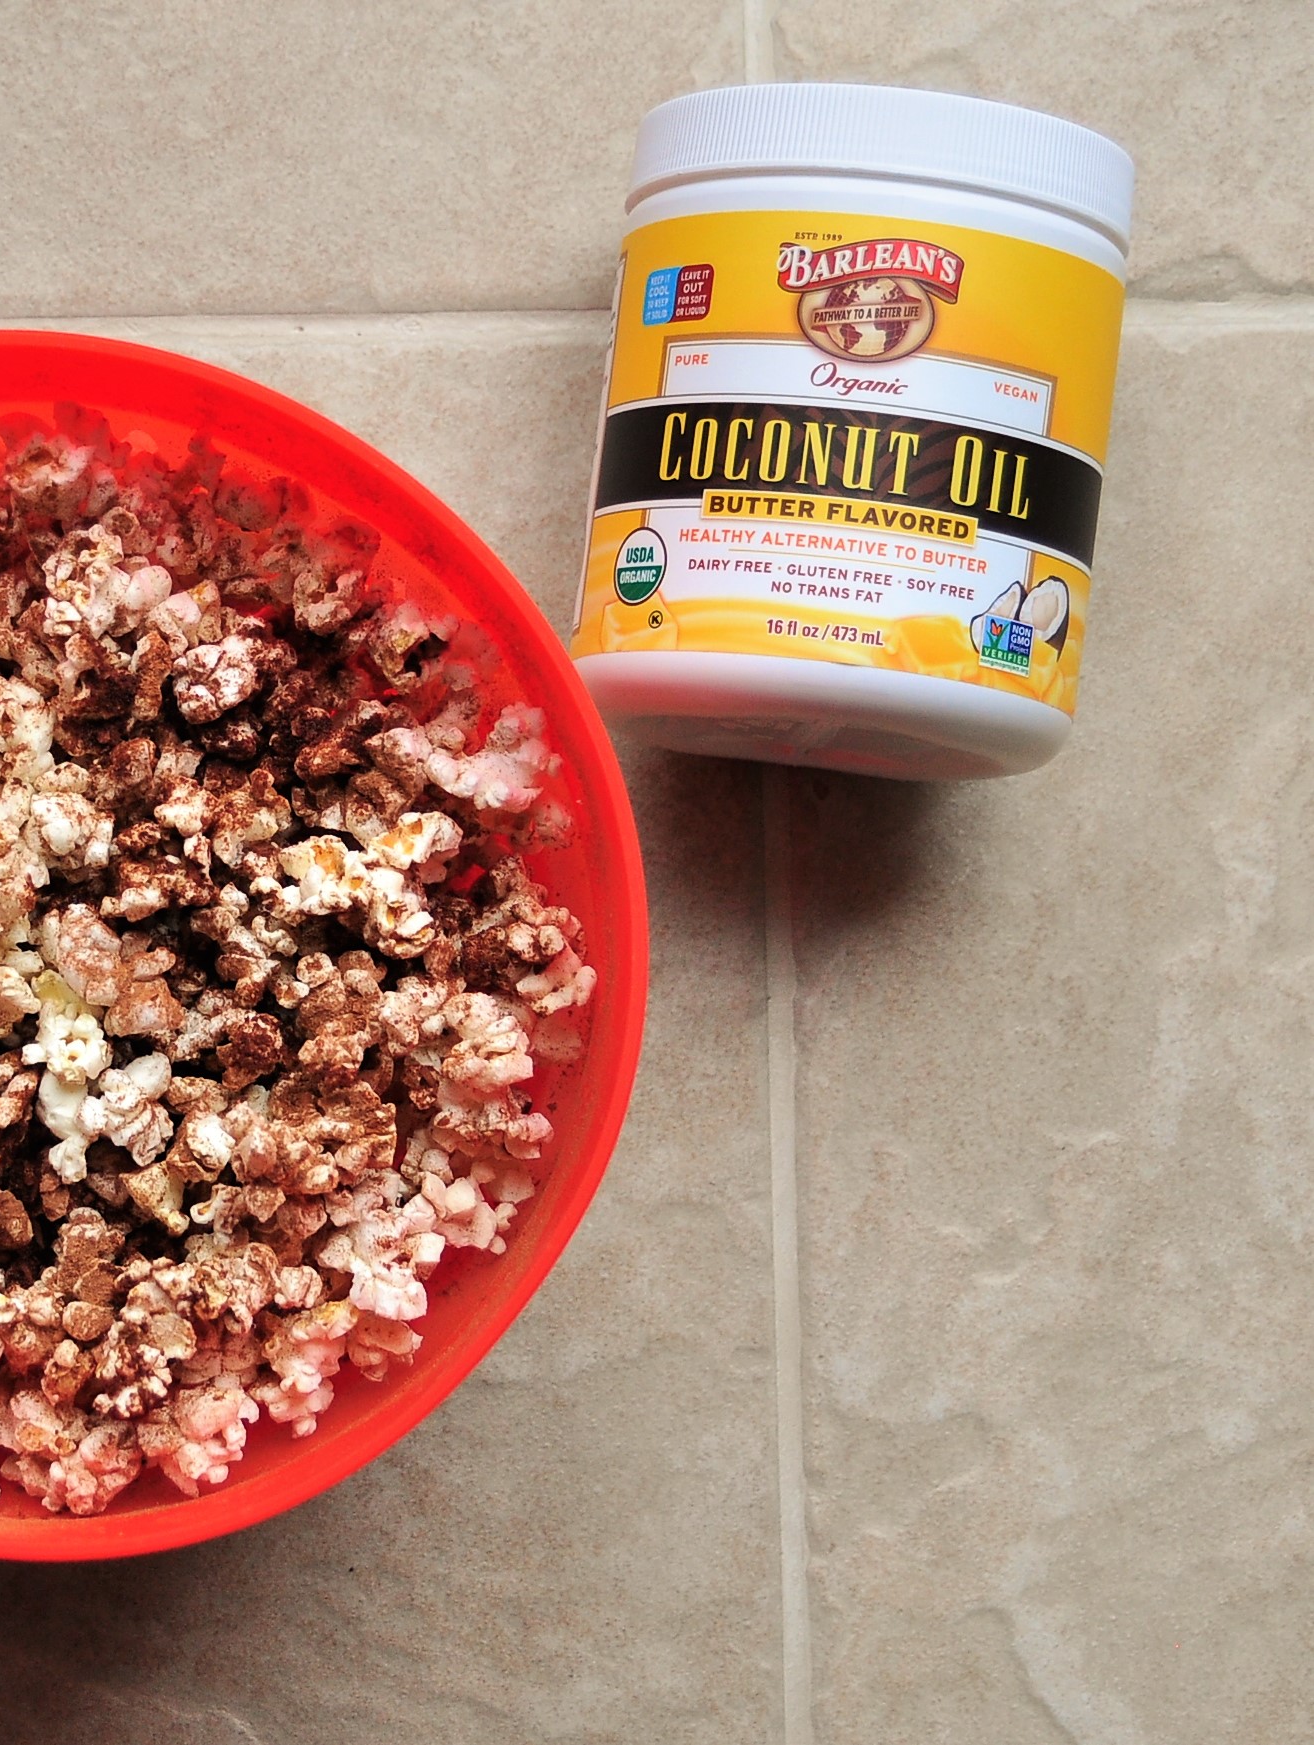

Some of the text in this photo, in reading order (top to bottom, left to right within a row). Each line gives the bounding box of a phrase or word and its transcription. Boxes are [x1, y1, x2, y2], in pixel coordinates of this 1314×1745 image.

[822, 233, 843, 242] 1989
[776, 245, 957, 287] BARLEAN'S
[681, 270, 710, 281] LEAVE IT
[649, 286, 669, 297] COOL
[683, 282, 704, 293] OUT
[678, 295, 707, 305] FOR SOFT
[676, 306, 706, 316] OR LIQUID
[814, 306, 919, 322] PATHWAY TO A BETTER LIFE
[675, 353, 709, 366] PURE
[810, 362, 908, 395] Organic
[994, 381, 1038, 403] VEGAN
[659, 412, 1029, 520] COCONUT OIL
[709, 496, 969, 539] BUTTER FLAVORED
[626, 546, 654, 563] USDA
[679, 529, 987, 574] HEALTHY ALTERNATIVE TO BUTTER
[619, 569, 656, 584] ORGANIC
[688, 558, 975, 600] DAIRY FREE GLUTEN FREE SOY FREE
[771, 581, 883, 604] NO TRANS FAT
[767, 619, 783, 634] 16
[787, 620, 797, 635] fl
[802, 626, 819, 638] oz
[861, 630, 883, 646] mL
[1012, 624, 1031, 637] NON
[1011, 634, 1030, 647] GMO
[984, 647, 1028, 666] VERIFIED
